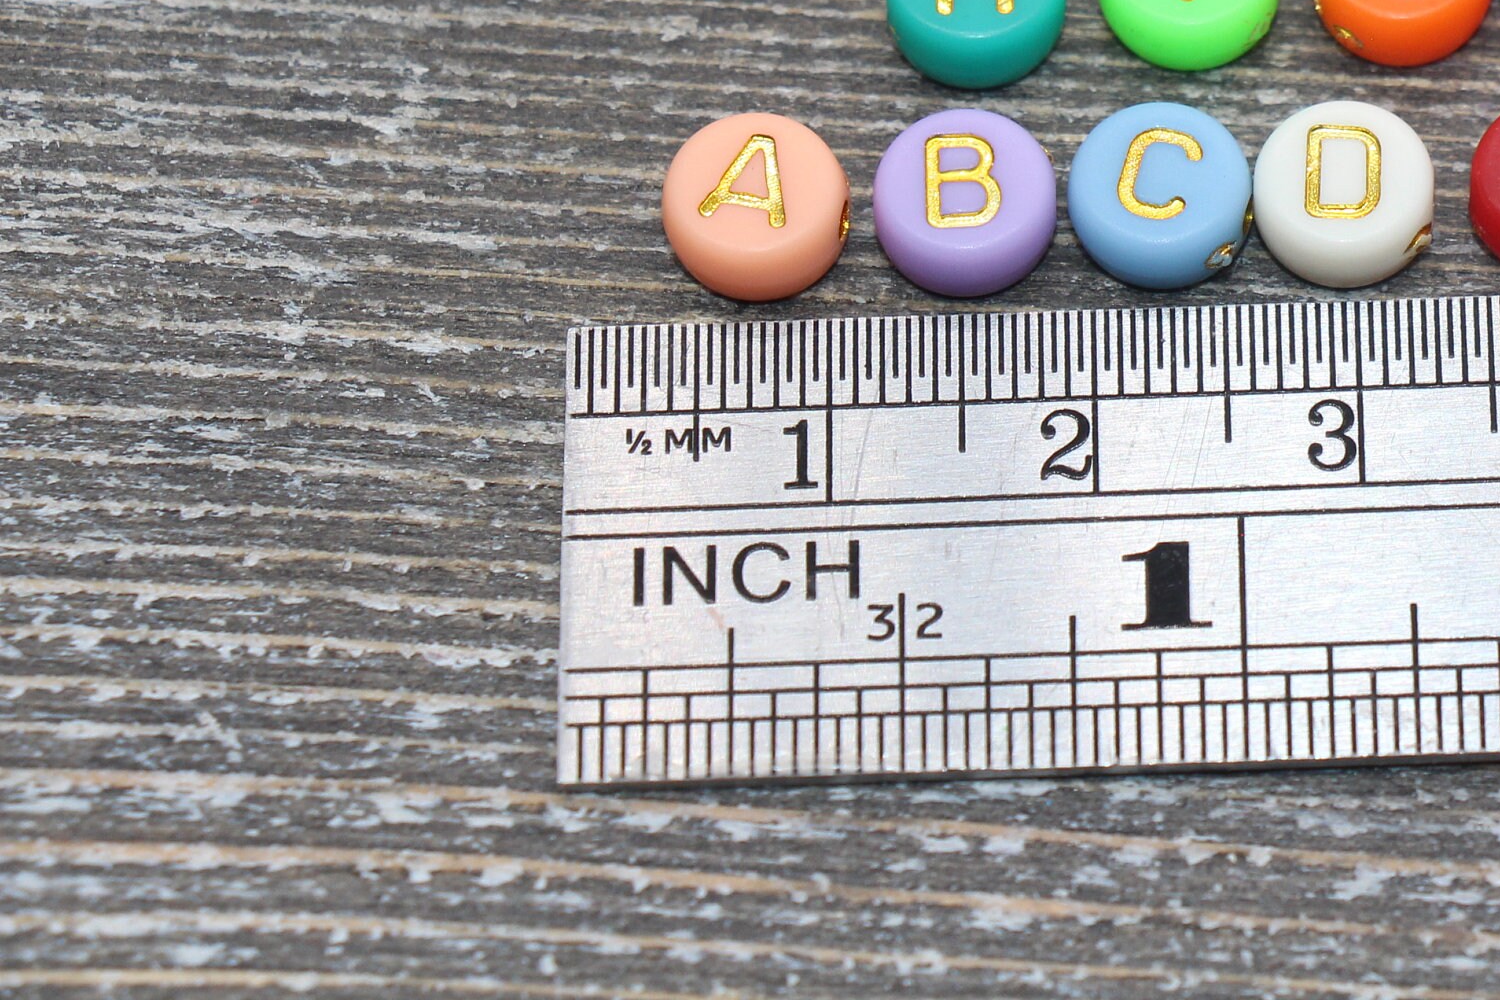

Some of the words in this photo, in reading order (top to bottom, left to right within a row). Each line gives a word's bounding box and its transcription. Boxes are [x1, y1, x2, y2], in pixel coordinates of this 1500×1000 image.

[697, 134, 787, 229] A
[924, 134, 1002, 229] B
[1116, 127, 1204, 221] C
[1304, 124, 1382, 219] D
[783, 419, 818, 490] 1
[1041, 409, 1093, 481] 2
[1307, 399, 1357, 473] 3
[632, 539, 861, 607] INCH
[867, 602, 944, 642] 32
[1121, 541, 1214, 631] 1
